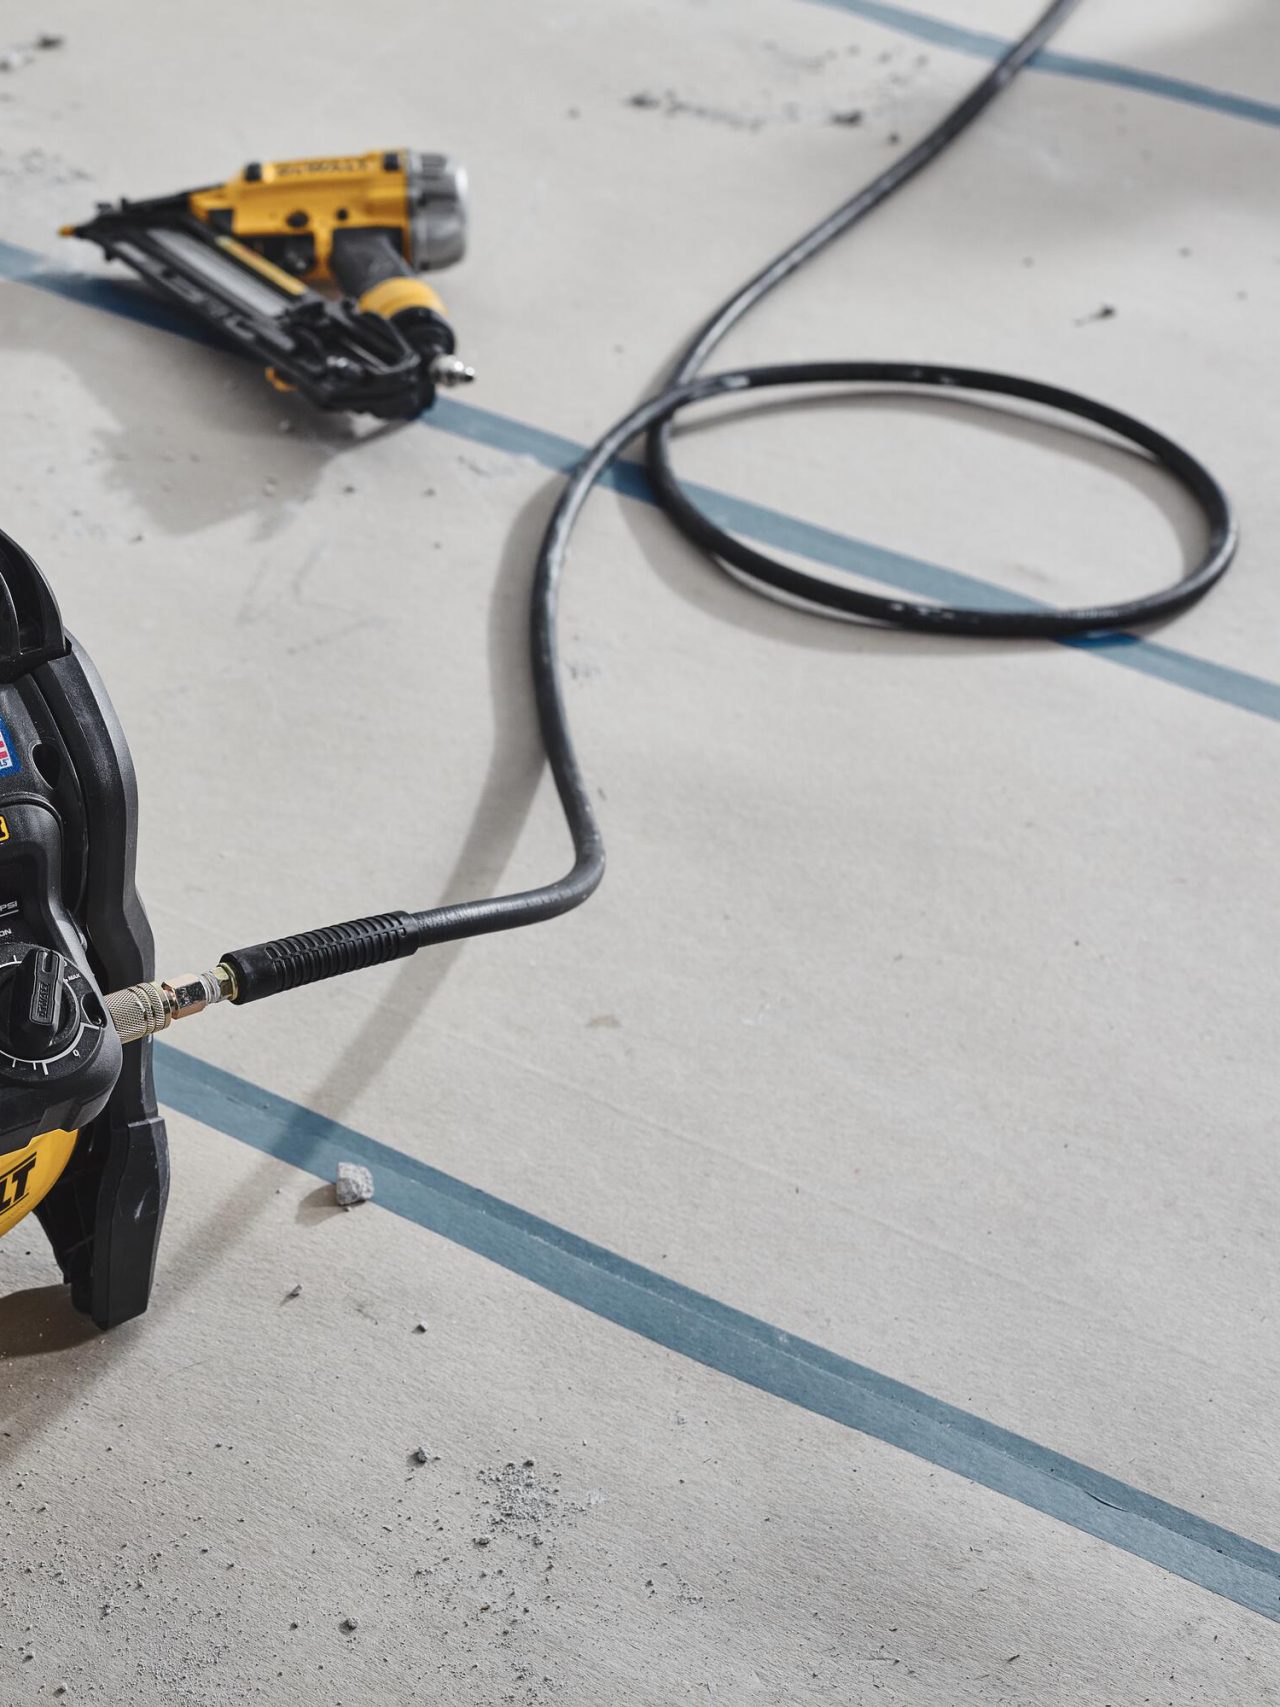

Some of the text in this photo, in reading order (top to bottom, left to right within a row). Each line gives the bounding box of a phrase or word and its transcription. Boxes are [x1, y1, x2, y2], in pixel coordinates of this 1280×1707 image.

[0, 900, 18, 912] PSI
[68, 973, 81, 981] MAX
[73, 1049, 80, 1057] 0
